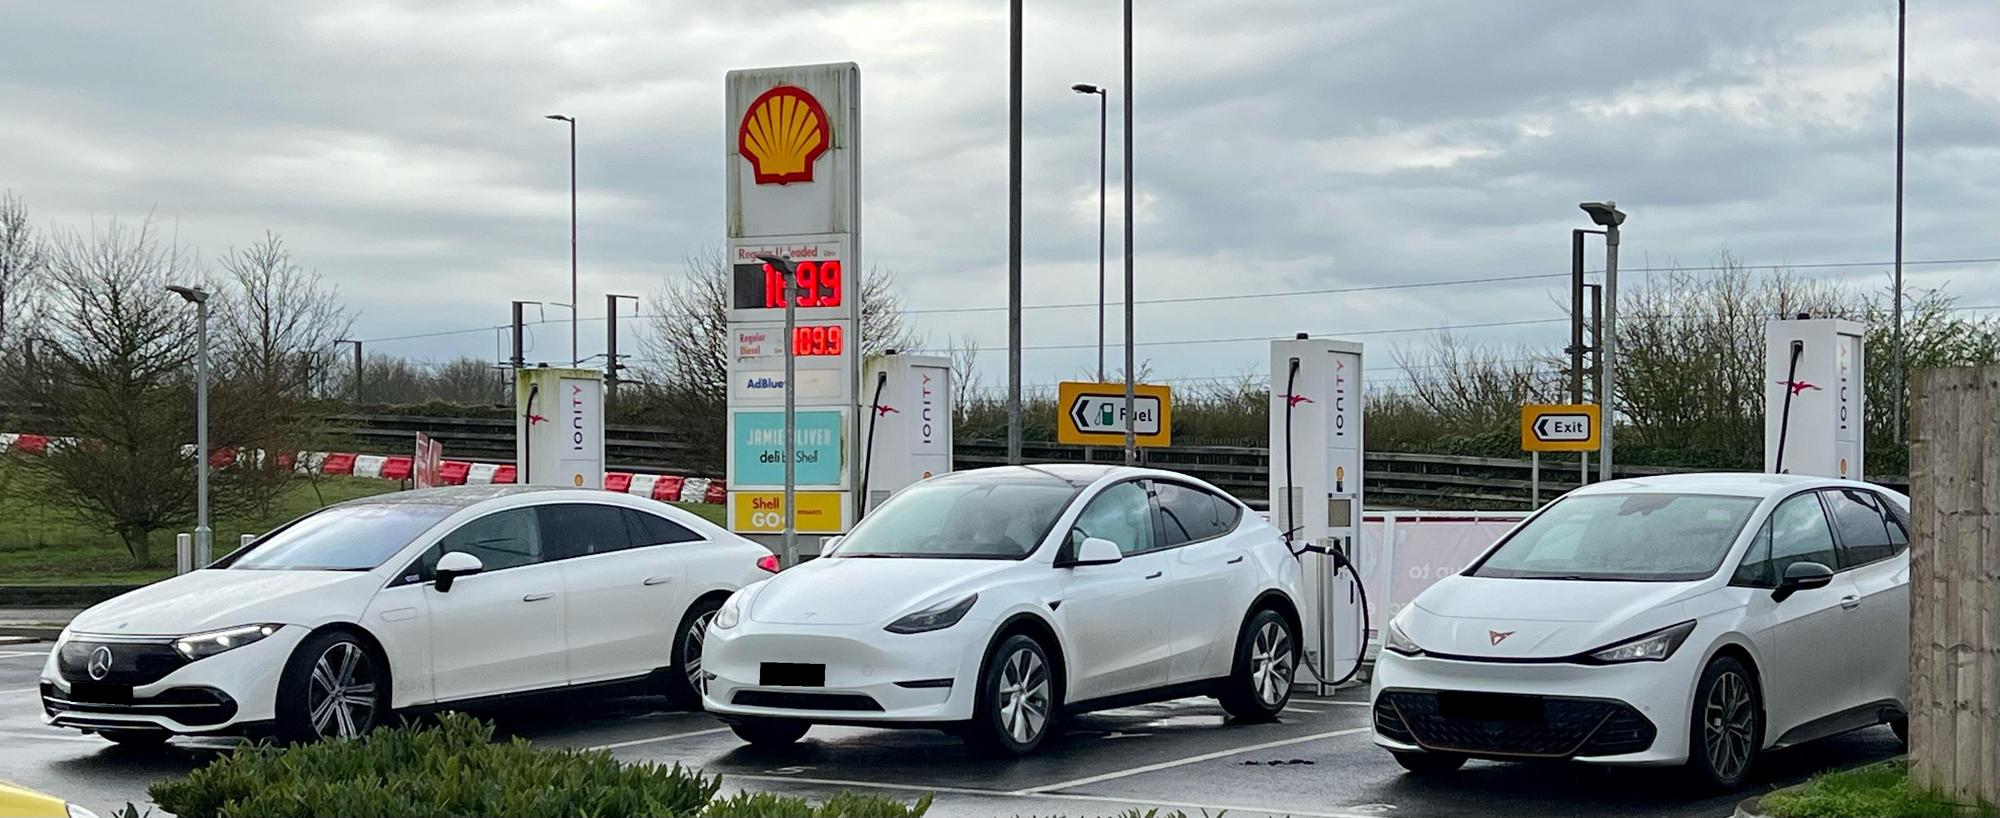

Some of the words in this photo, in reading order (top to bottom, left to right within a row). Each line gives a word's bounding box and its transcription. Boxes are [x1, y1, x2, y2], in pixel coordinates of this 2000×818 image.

[776, 245, 818, 258] Ueaded
[740, 332, 766, 345] Regular
[740, 345, 760, 355] Diesel
[747, 378, 784, 389] AdBlue
[1336, 360, 1344, 436] IONITY
[923, 374, 931, 444] IONITY
[573, 384, 583, 450] IONITY
[1554, 421, 1582, 433] Exit
[747, 428, 784, 446] JAMIE
[794, 428, 832, 446] LIVER
[760, 450, 780, 463] deli
[796, 450, 818, 463] Shell
[752, 497, 779, 509] Shell
